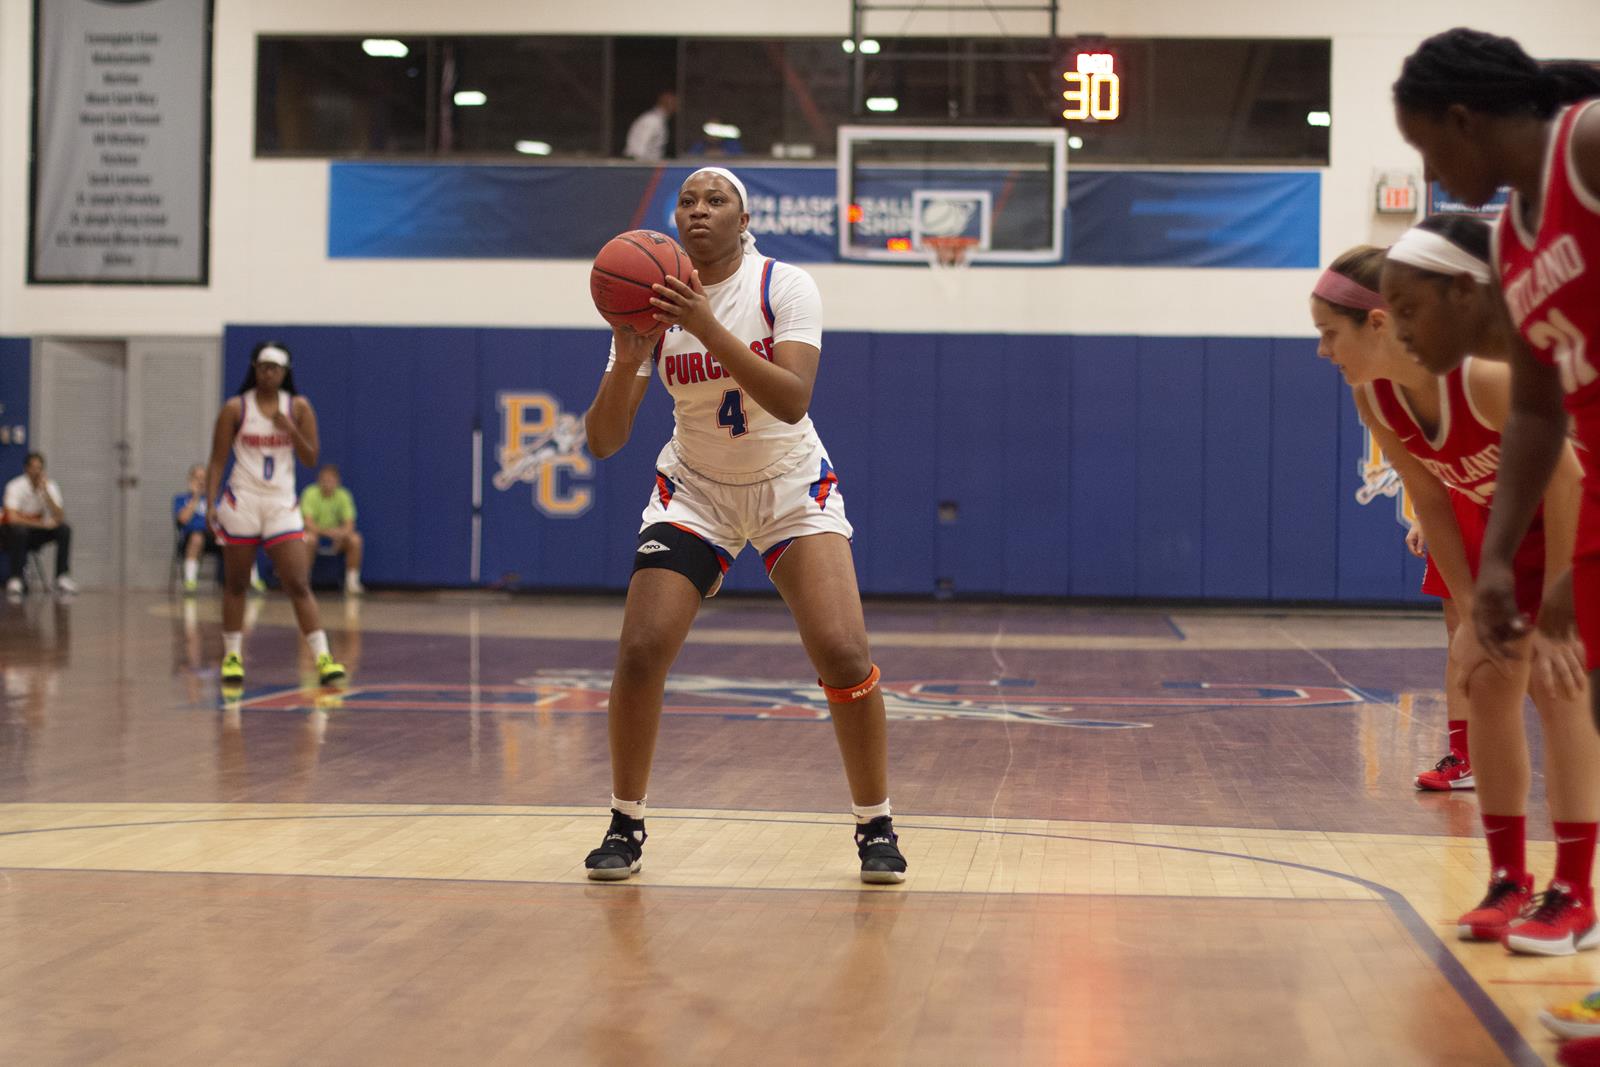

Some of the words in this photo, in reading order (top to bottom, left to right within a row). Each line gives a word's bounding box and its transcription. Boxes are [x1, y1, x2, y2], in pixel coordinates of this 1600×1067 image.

[1062, 71, 1120, 120] 30
[664, 336, 775, 387] PURCSE
[716, 387, 749, 439] 4
